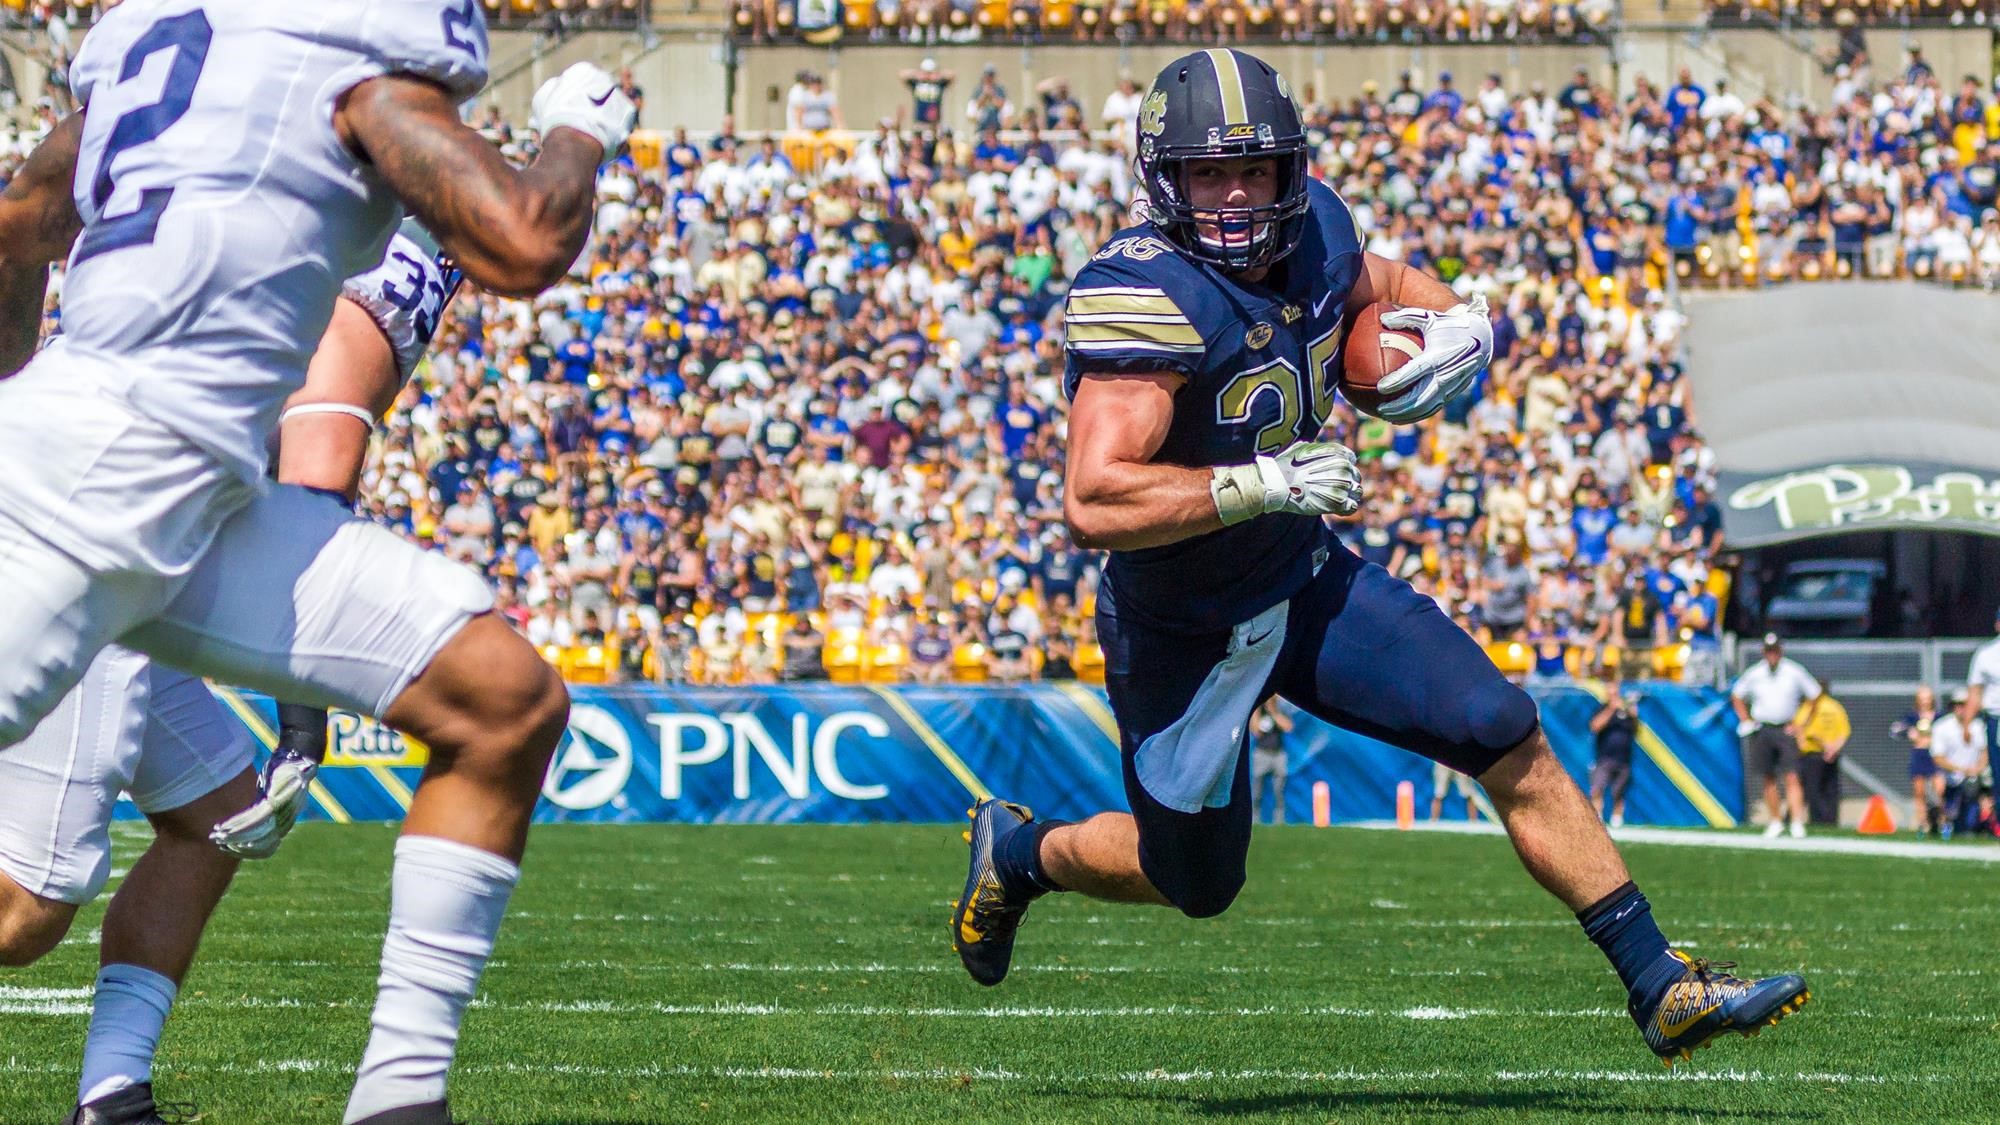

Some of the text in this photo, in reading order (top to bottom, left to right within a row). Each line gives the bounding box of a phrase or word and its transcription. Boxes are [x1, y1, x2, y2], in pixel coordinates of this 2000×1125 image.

[71, 8, 213, 268] 2
[1225, 126, 1256, 136] ACC
[1092, 236, 1174, 261] 35
[329, 710, 407, 757] Pitt
[645, 711, 890, 800] PNC
